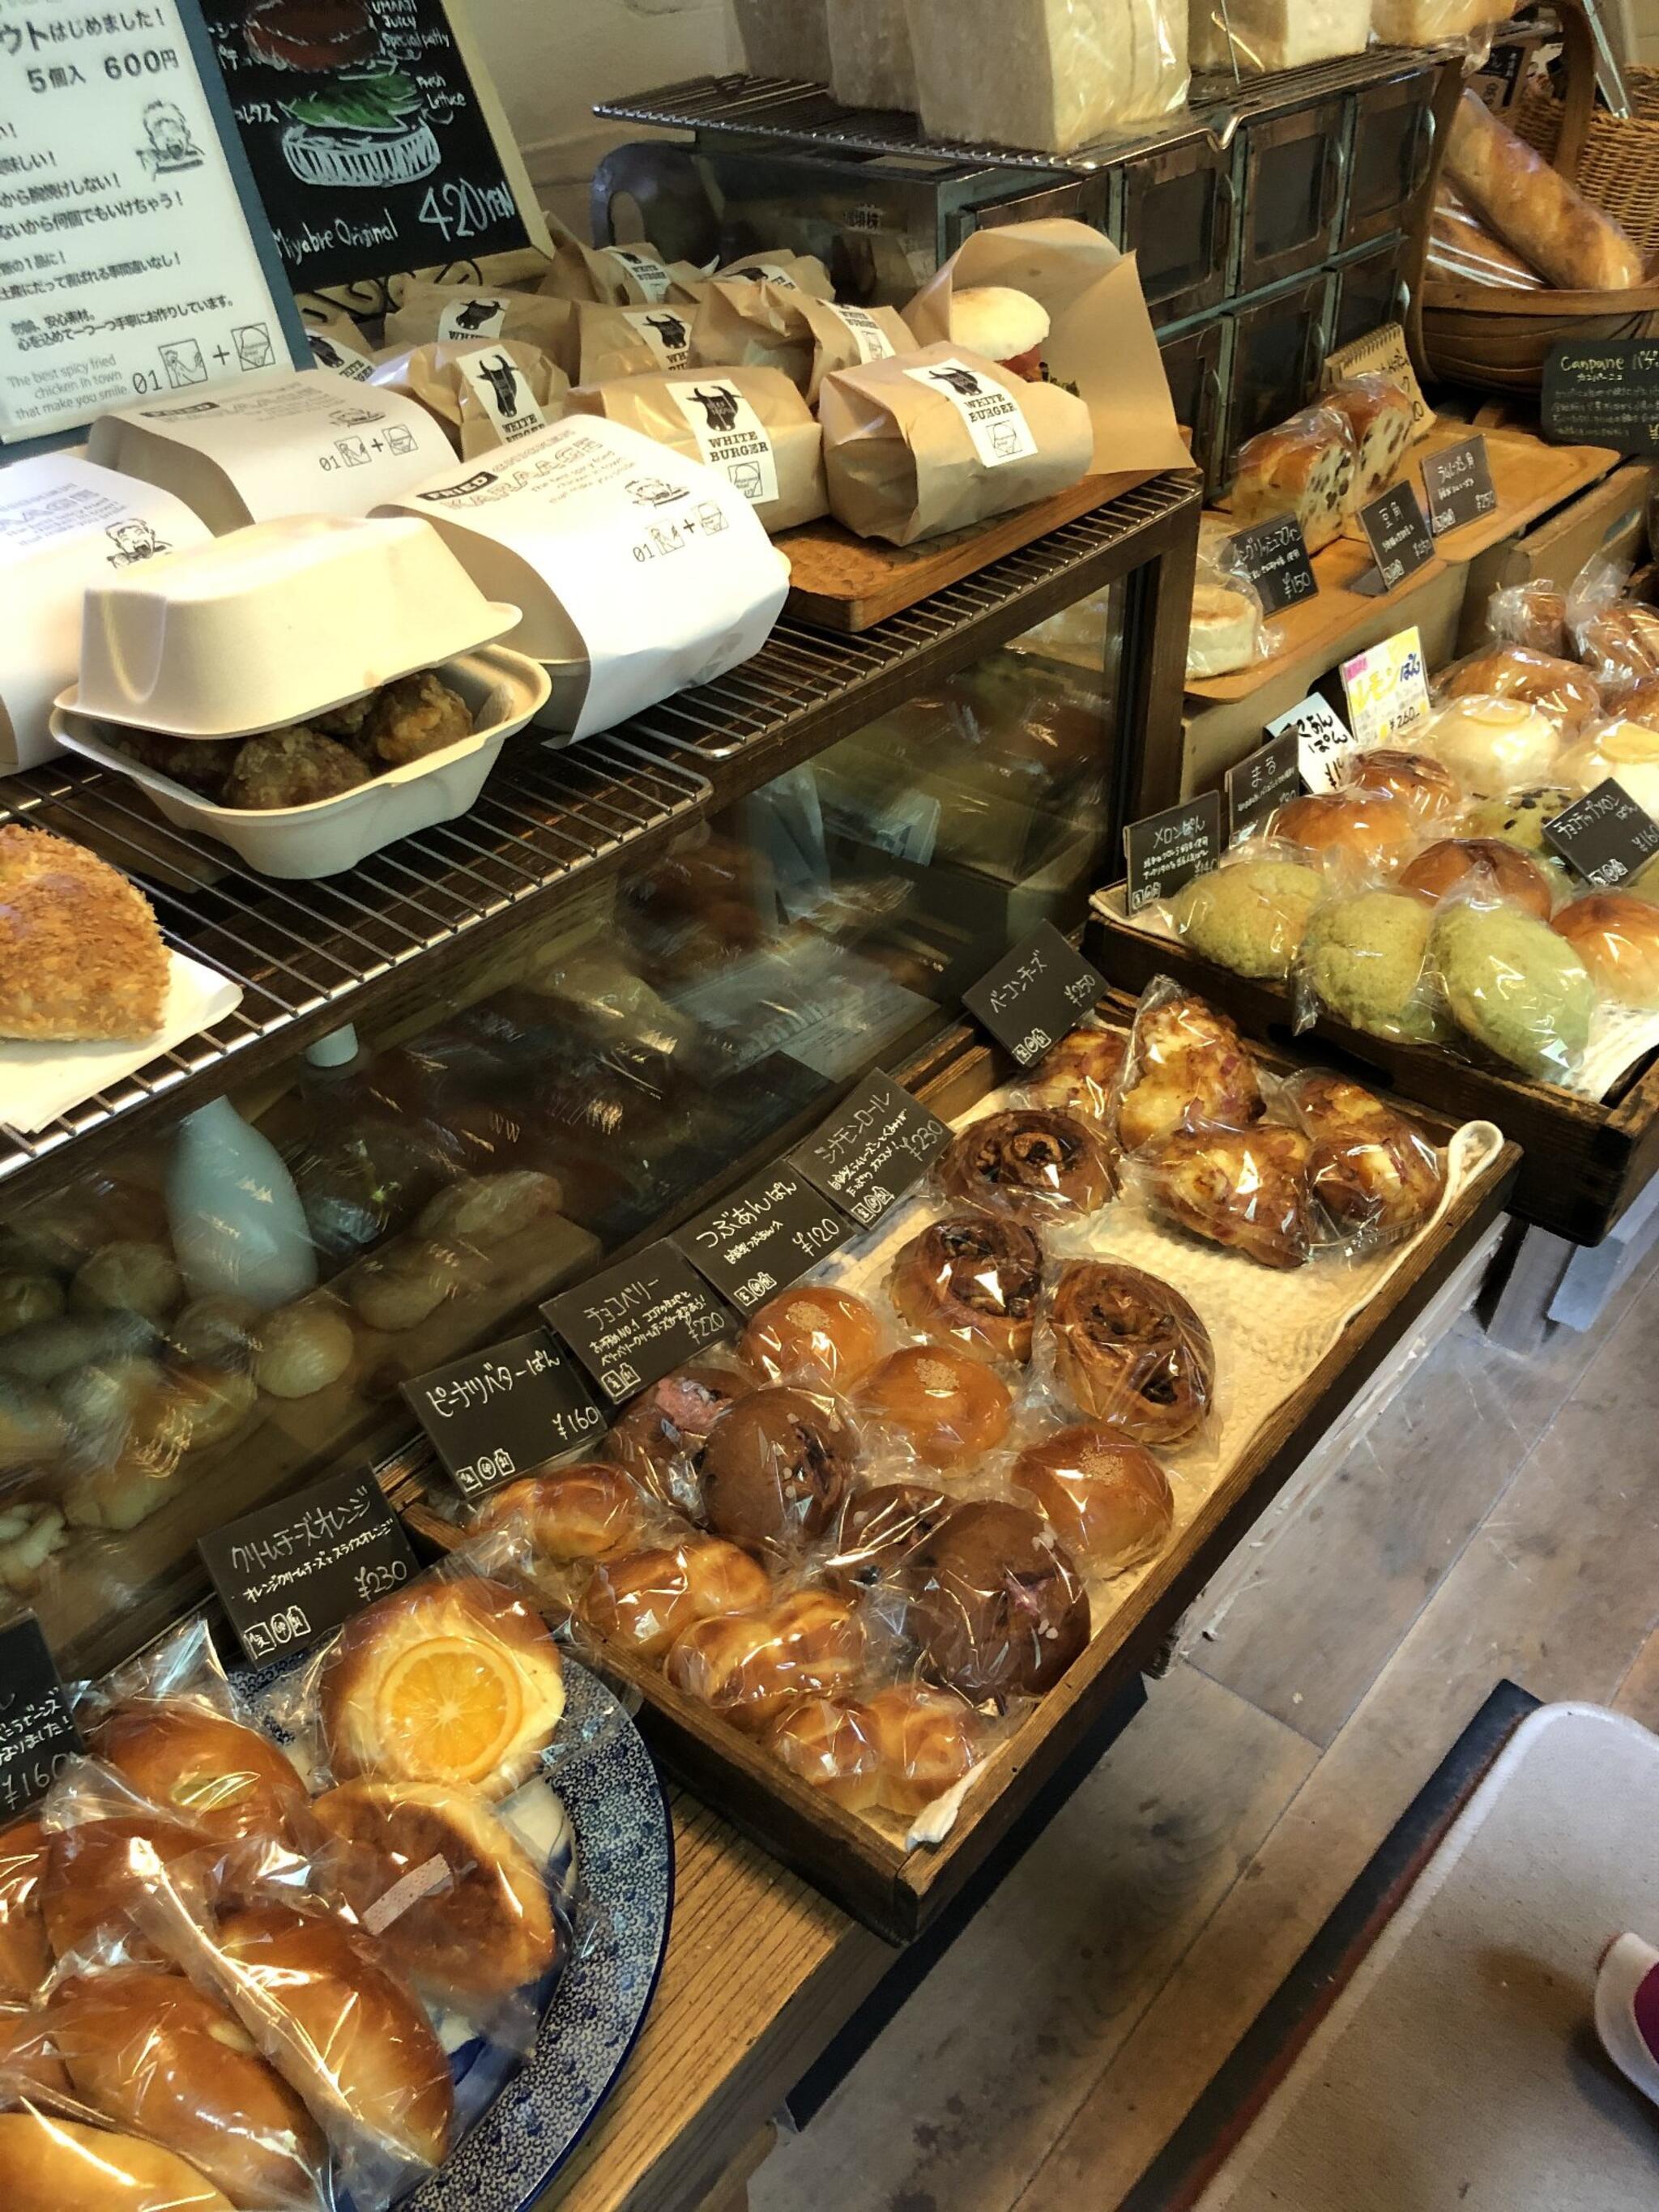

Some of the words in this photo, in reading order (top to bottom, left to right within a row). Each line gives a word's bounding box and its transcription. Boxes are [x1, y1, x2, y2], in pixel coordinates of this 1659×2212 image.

[27, 63, 87, 94] 5個入
[104, 49, 180, 79] 600円
[7, 373, 31, 389] The
[32, 367, 62, 385] best
[35, 380, 78, 400] chicken
[93, 369, 122, 387] town
[16, 407, 41, 421] that
[43, 396, 74, 412] make
[75, 392, 99, 410] you
[963, 393, 1006, 410] WHITE
[967, 402, 1017, 423] BURGER
[501, 413, 538, 433] WHITE
[708, 430, 759, 449] WHITE
[318, 454, 341, 472] 01
[709, 441, 770, 462] BURGER
[426, 475, 490, 500] FRIED
[633, 543, 655, 563] 01
[1282, 569, 1311, 601] ¥150
[989, 948, 1049, 1014] ベーコンチーズ
[813, 1092, 890, 1164] シナモンロール
[898, 1119, 943, 1162] ¥230
[696, 1181, 797, 1248] つぶあんぱん
[791, 1217, 839, 1257] ¥120
[583, 1279, 659, 1332] チョコベリー
[684, 1311, 726, 1345] ¥220
[426, 1349, 561, 1417] ピーナツバターぱん
[552, 1405, 599, 1440] ¥160
[231, 1485, 371, 1574] クリームチーズオレンジ
[353, 1560, 407, 1603] ¥230
